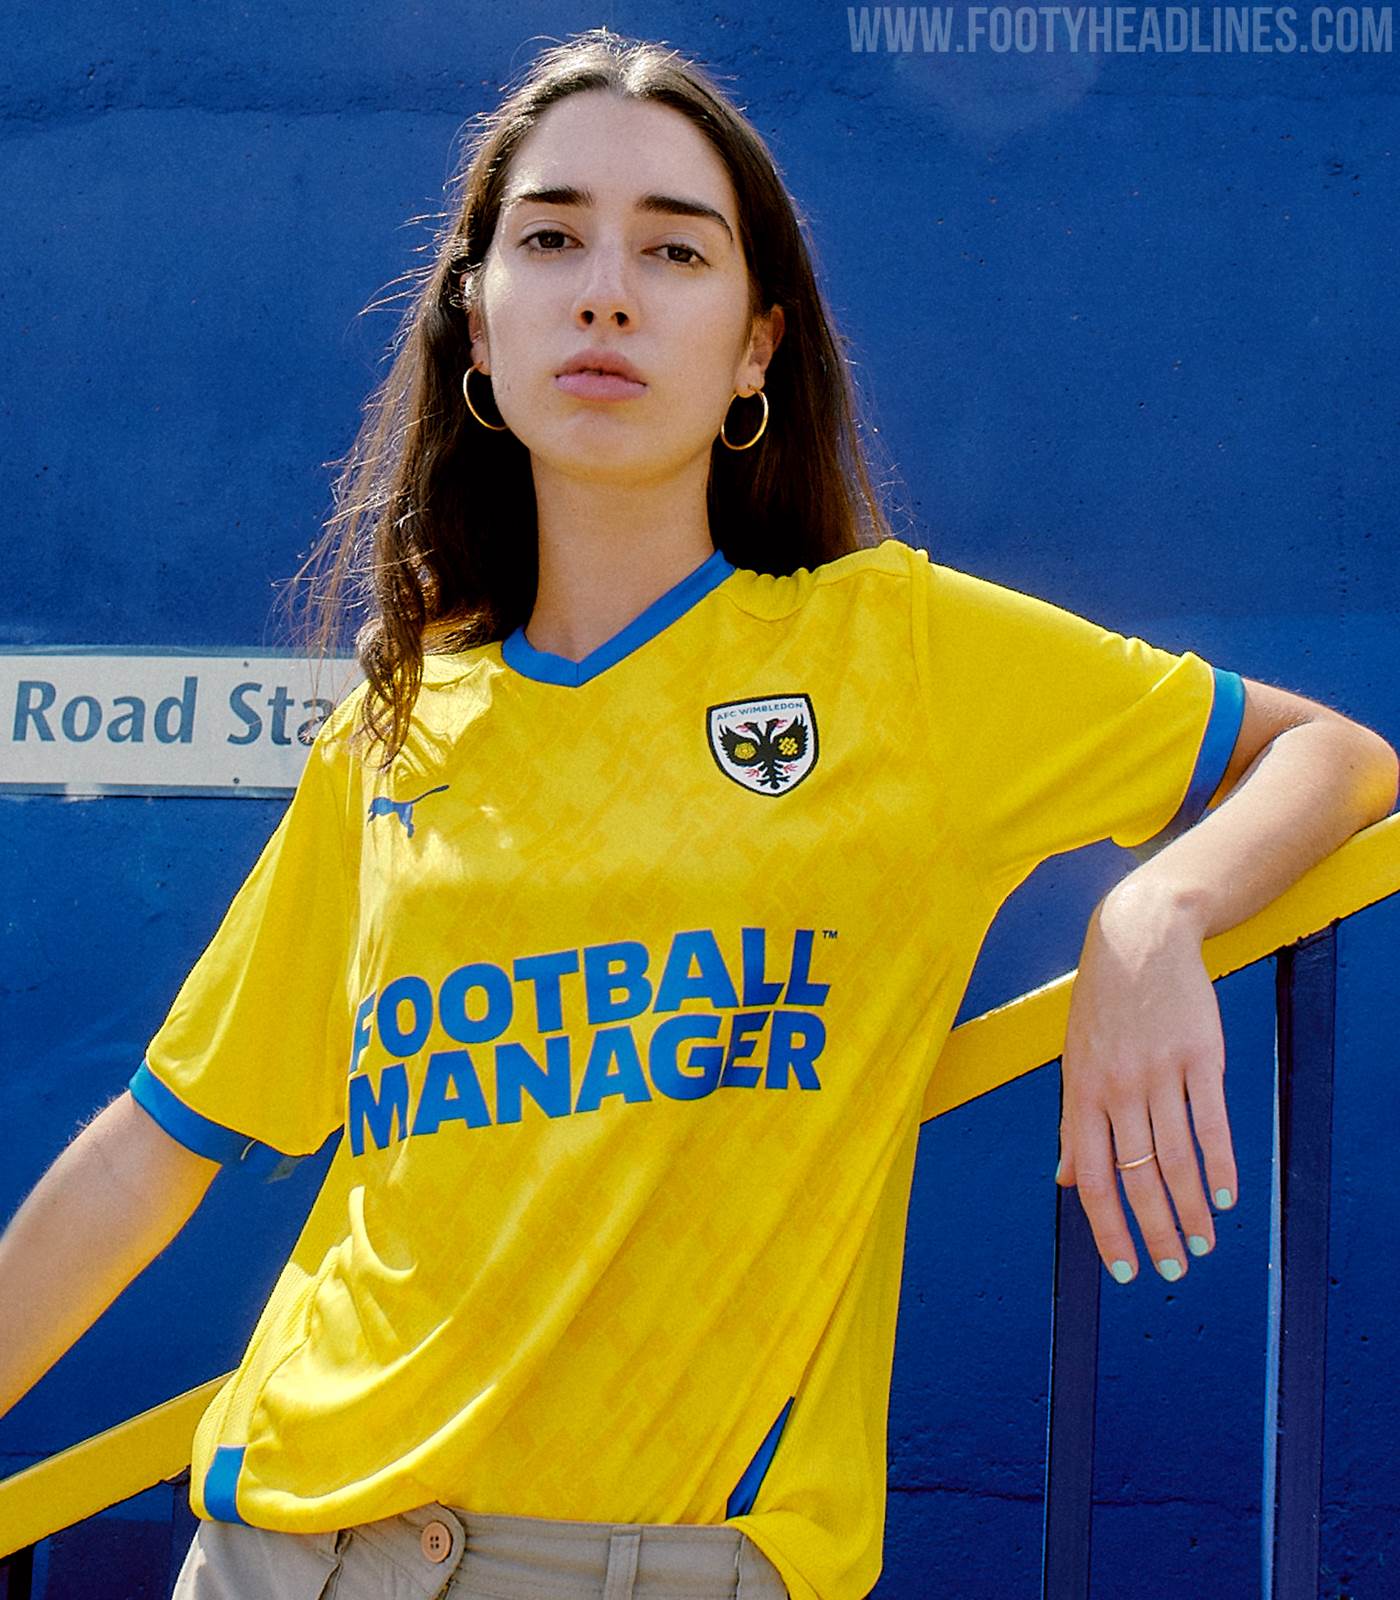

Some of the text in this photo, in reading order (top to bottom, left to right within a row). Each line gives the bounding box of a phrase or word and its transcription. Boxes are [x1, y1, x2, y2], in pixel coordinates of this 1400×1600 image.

[12, 676, 335, 746] Road Sta
[716, 702, 803, 721] AFC WIMBLEDON
[350, 927, 831, 1072] FOOTBALL
[348, 1010, 827, 1157] MANAGER
